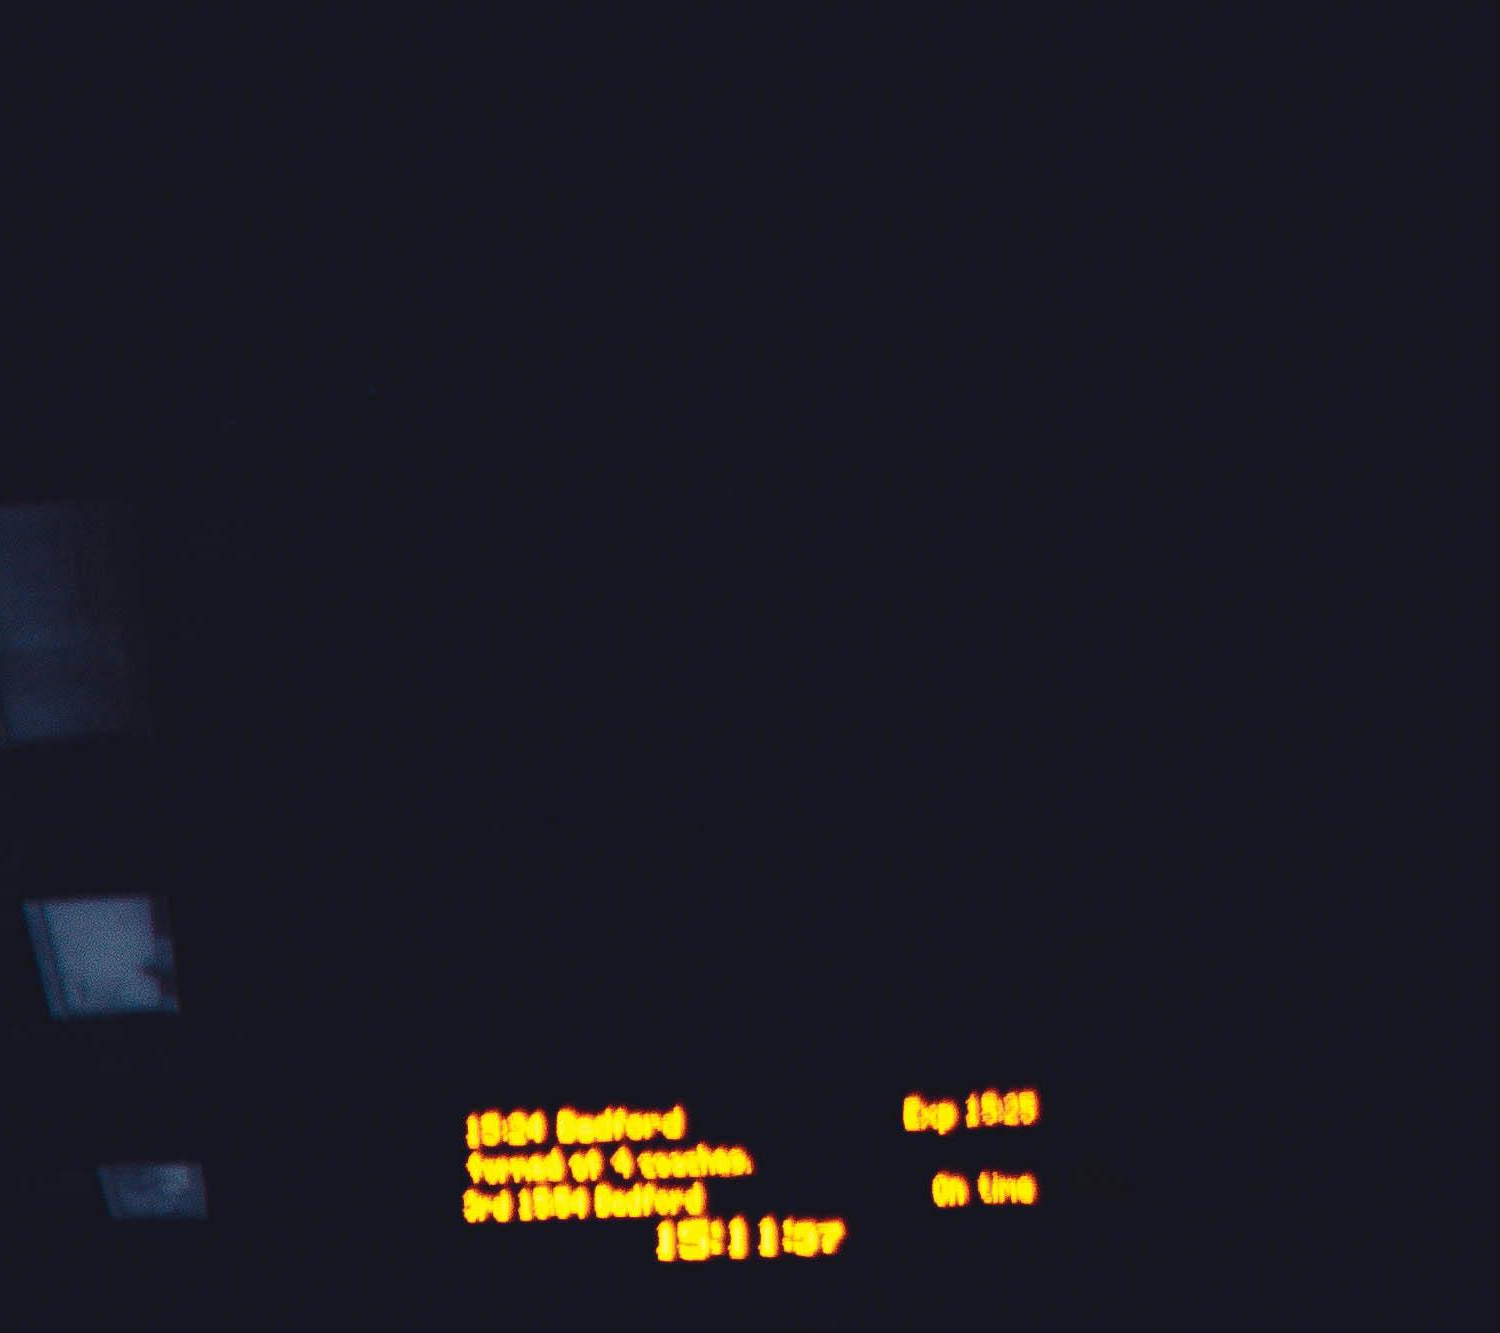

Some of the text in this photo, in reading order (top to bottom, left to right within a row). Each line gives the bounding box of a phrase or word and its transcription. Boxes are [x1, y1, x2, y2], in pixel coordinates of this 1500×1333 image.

[556, 1105, 685, 1144] Bedford
[903, 1093, 959, 1135] Exp
[568, 1147, 605, 1183] of
[610, 1145, 634, 1179] 4
[593, 1181, 705, 1219] Bedford
[932, 1171, 1037, 1208] On time
